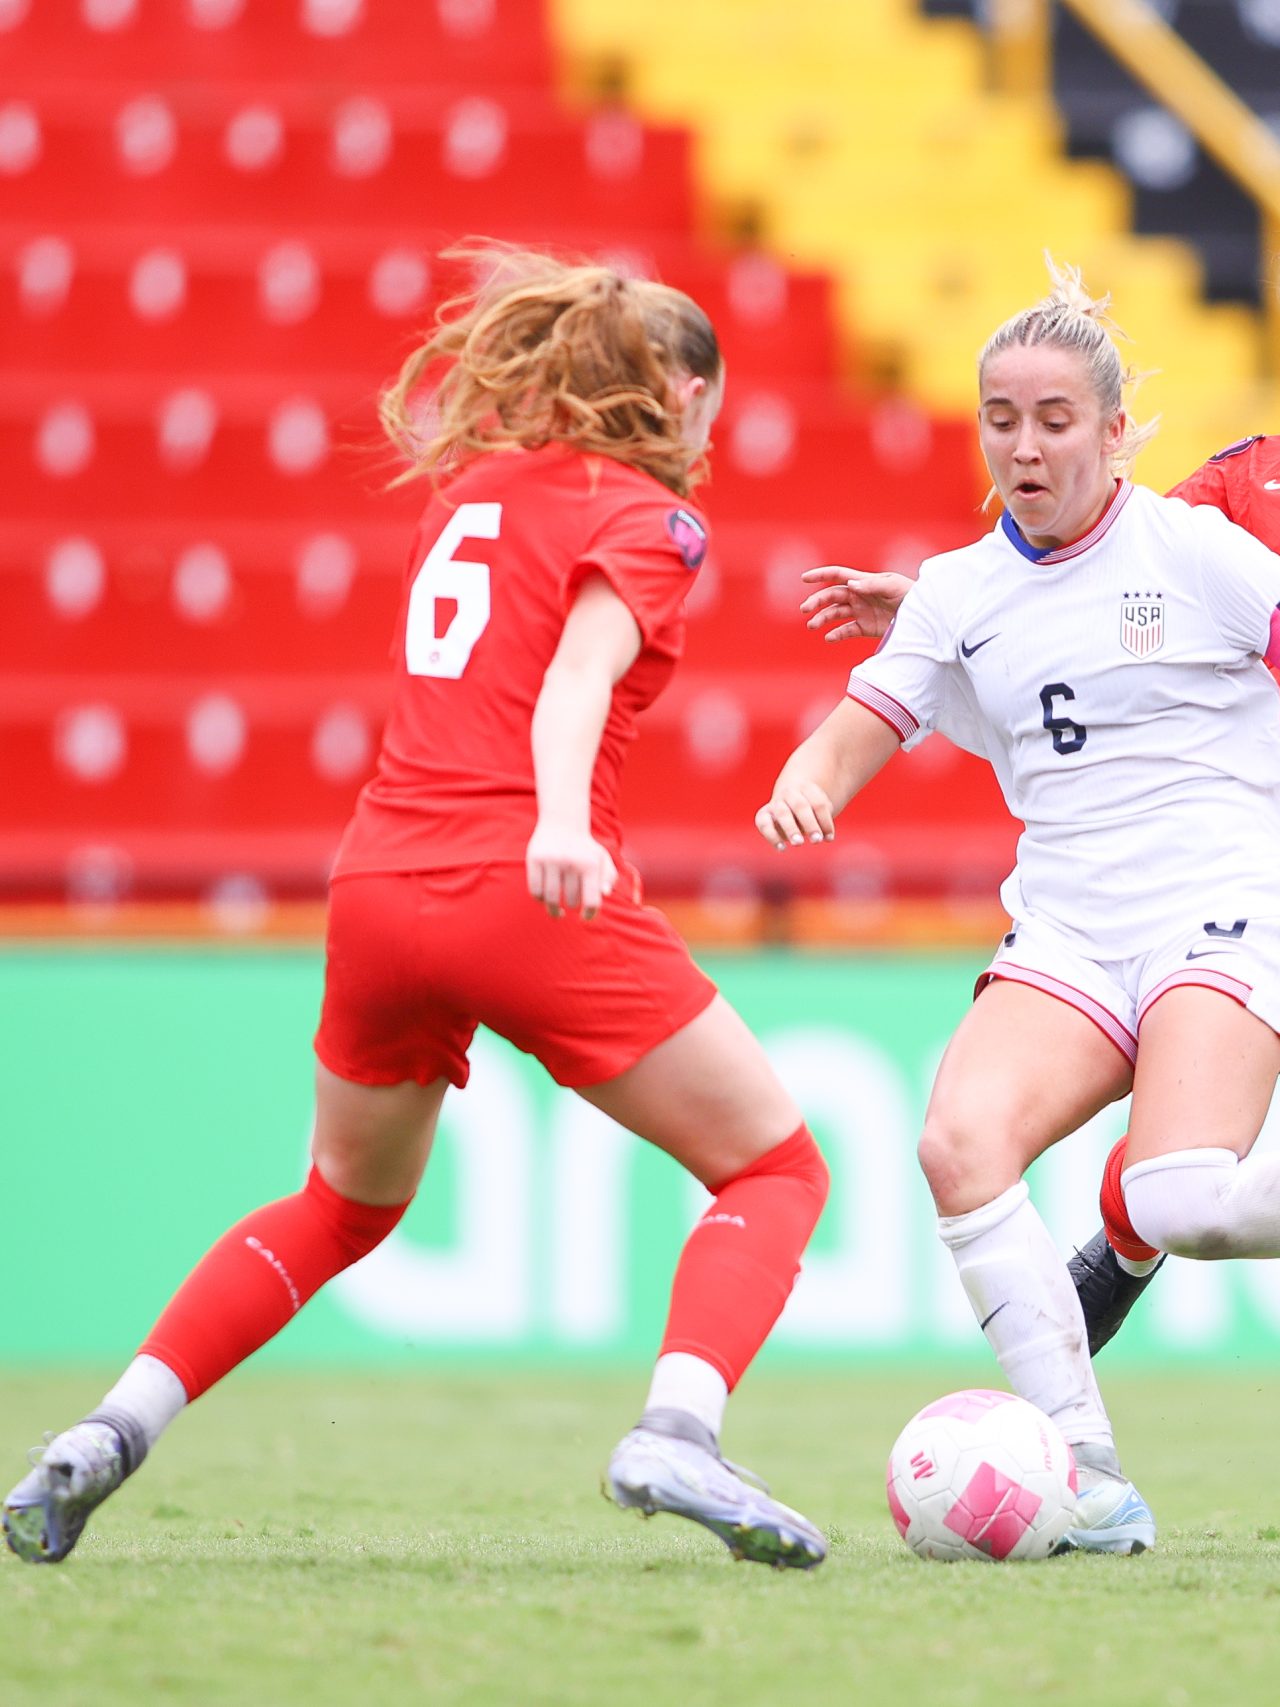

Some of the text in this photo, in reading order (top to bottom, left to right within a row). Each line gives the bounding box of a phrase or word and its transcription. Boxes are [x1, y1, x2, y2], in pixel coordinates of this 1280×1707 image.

[405, 502, 502, 680] 6
[1125, 606, 1160, 627] USA
[1039, 682, 1087, 755] 6
